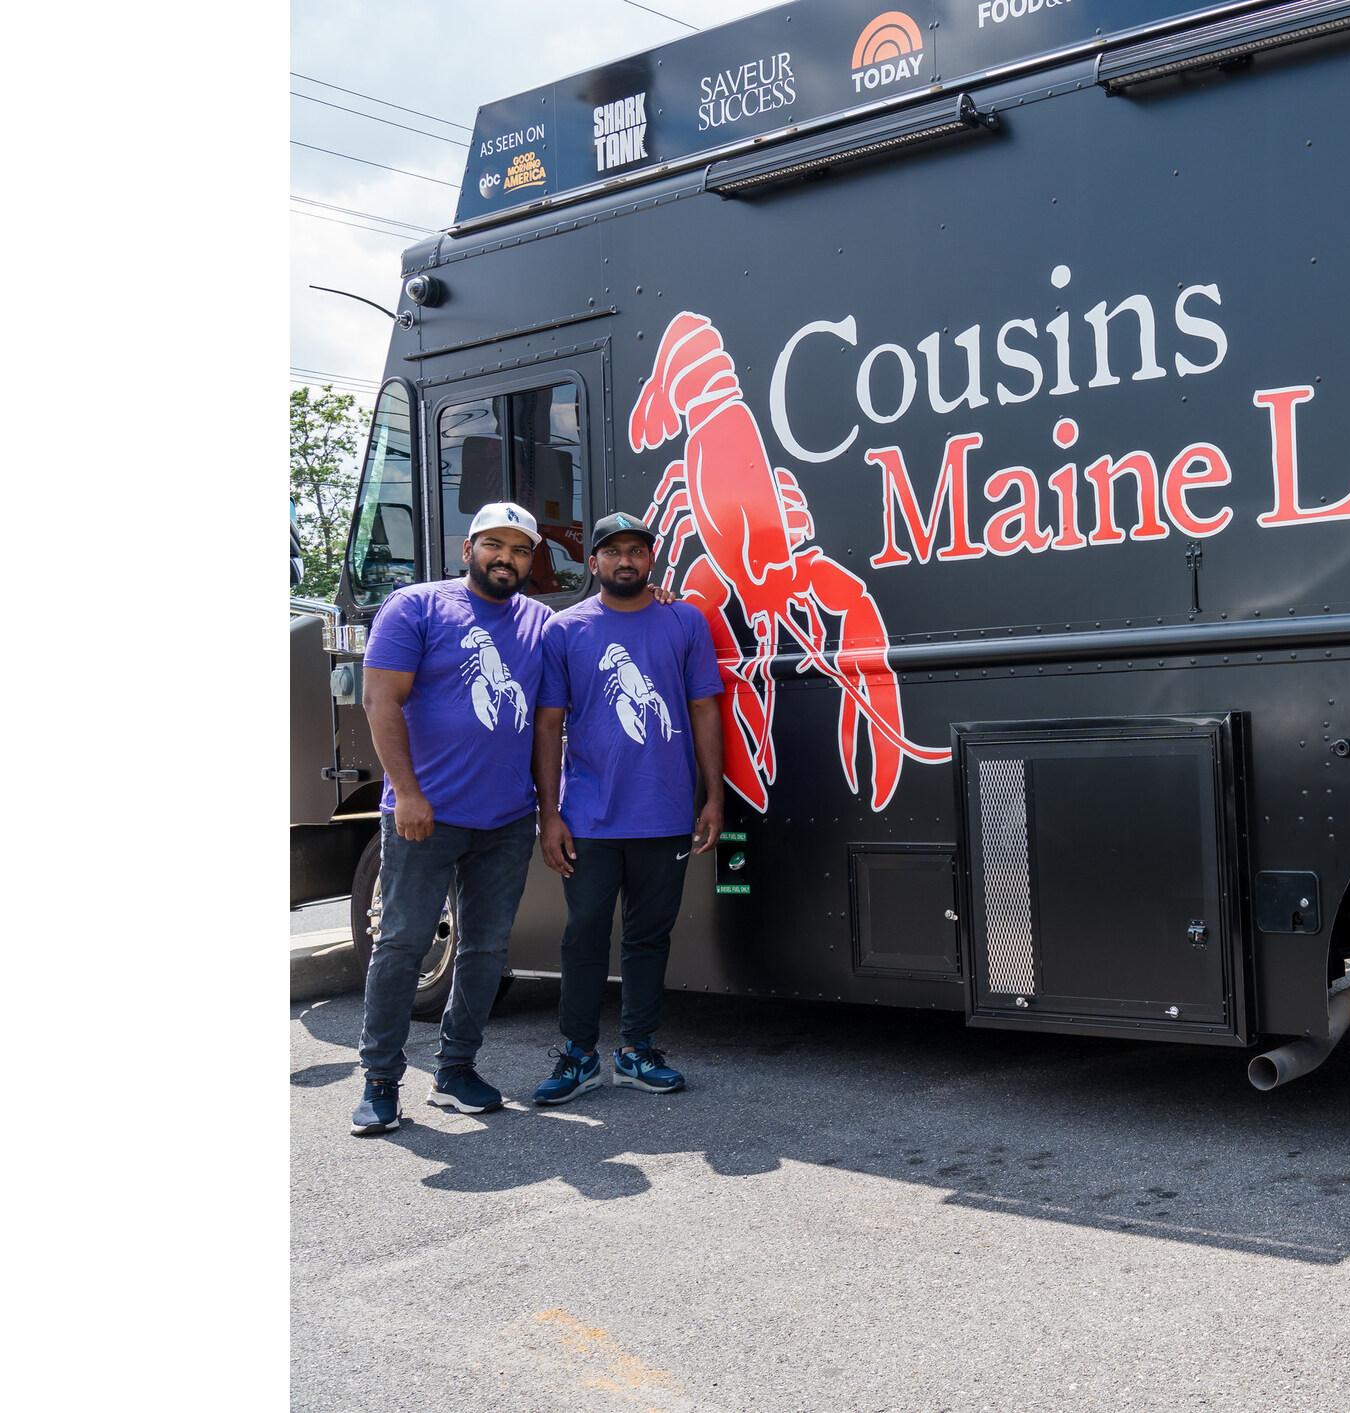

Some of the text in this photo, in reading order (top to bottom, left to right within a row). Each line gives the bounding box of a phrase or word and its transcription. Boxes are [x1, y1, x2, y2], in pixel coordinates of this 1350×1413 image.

[978, 0, 1073, 28] FOOD
[700, 52, 794, 104] SAVEUR
[852, 54, 923, 93] TODAY
[593, 92, 647, 138] SHARK
[698, 77, 796, 131] SUCCESS
[480, 124, 545, 158] AS SEEN ON
[512, 151, 536, 166] GOOD
[594, 123, 648, 172] TANK
[479, 173, 501, 188] abc
[503, 166, 547, 189] AMERICA
[507, 158, 542, 177] MORNING
[769, 264, 1228, 463] Cousins
[864, 417, 1232, 570] Maine
